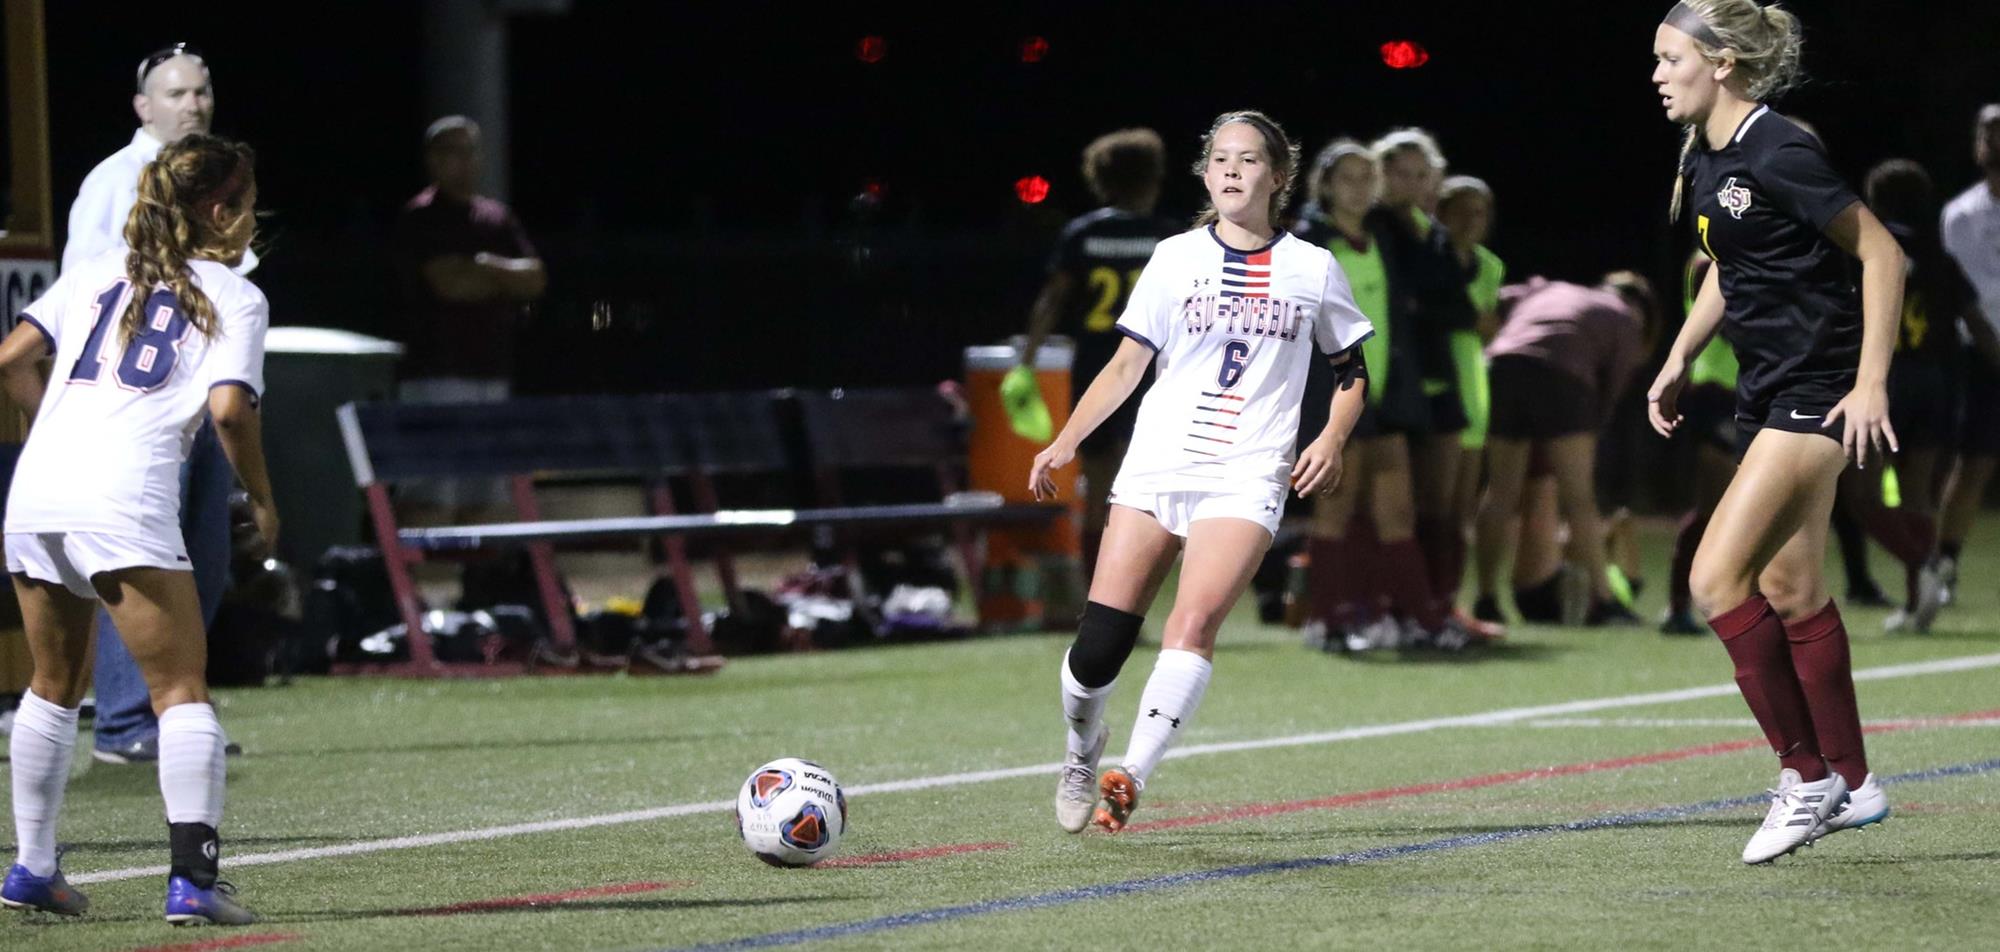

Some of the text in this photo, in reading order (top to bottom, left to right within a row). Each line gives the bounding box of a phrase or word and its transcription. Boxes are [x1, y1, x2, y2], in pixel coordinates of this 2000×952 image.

[1717, 188, 1752, 211] MSU
[1698, 215, 1718, 261] 7
[1085, 266, 1143, 332] 2
[65, 277, 193, 393] 18
[1215, 338, 1250, 391] 6
[801, 785, 833, 804] Wilson
